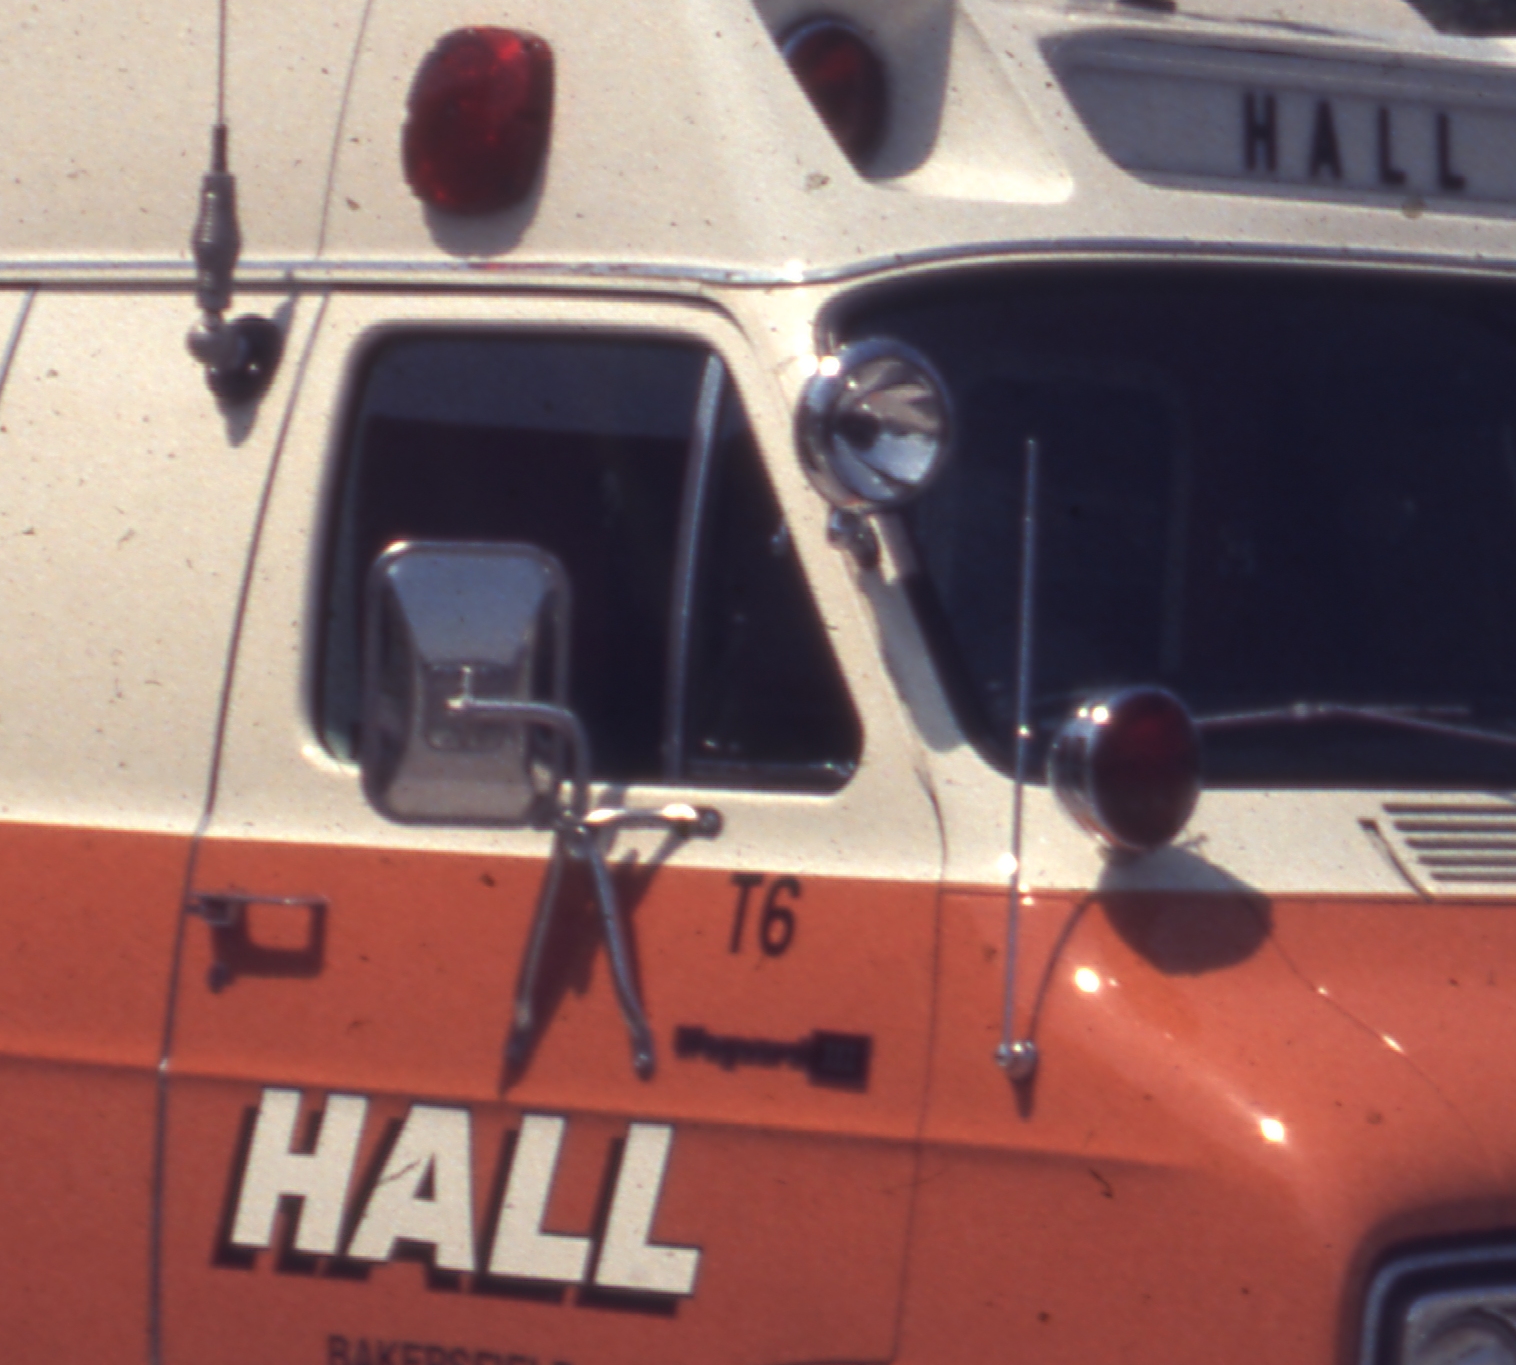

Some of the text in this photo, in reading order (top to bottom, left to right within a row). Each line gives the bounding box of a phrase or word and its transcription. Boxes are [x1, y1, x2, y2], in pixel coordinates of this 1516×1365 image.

[1243, 90, 1466, 190] HALL
[726, 873, 802, 958] T6
[212, 1086, 702, 1317] HALL
